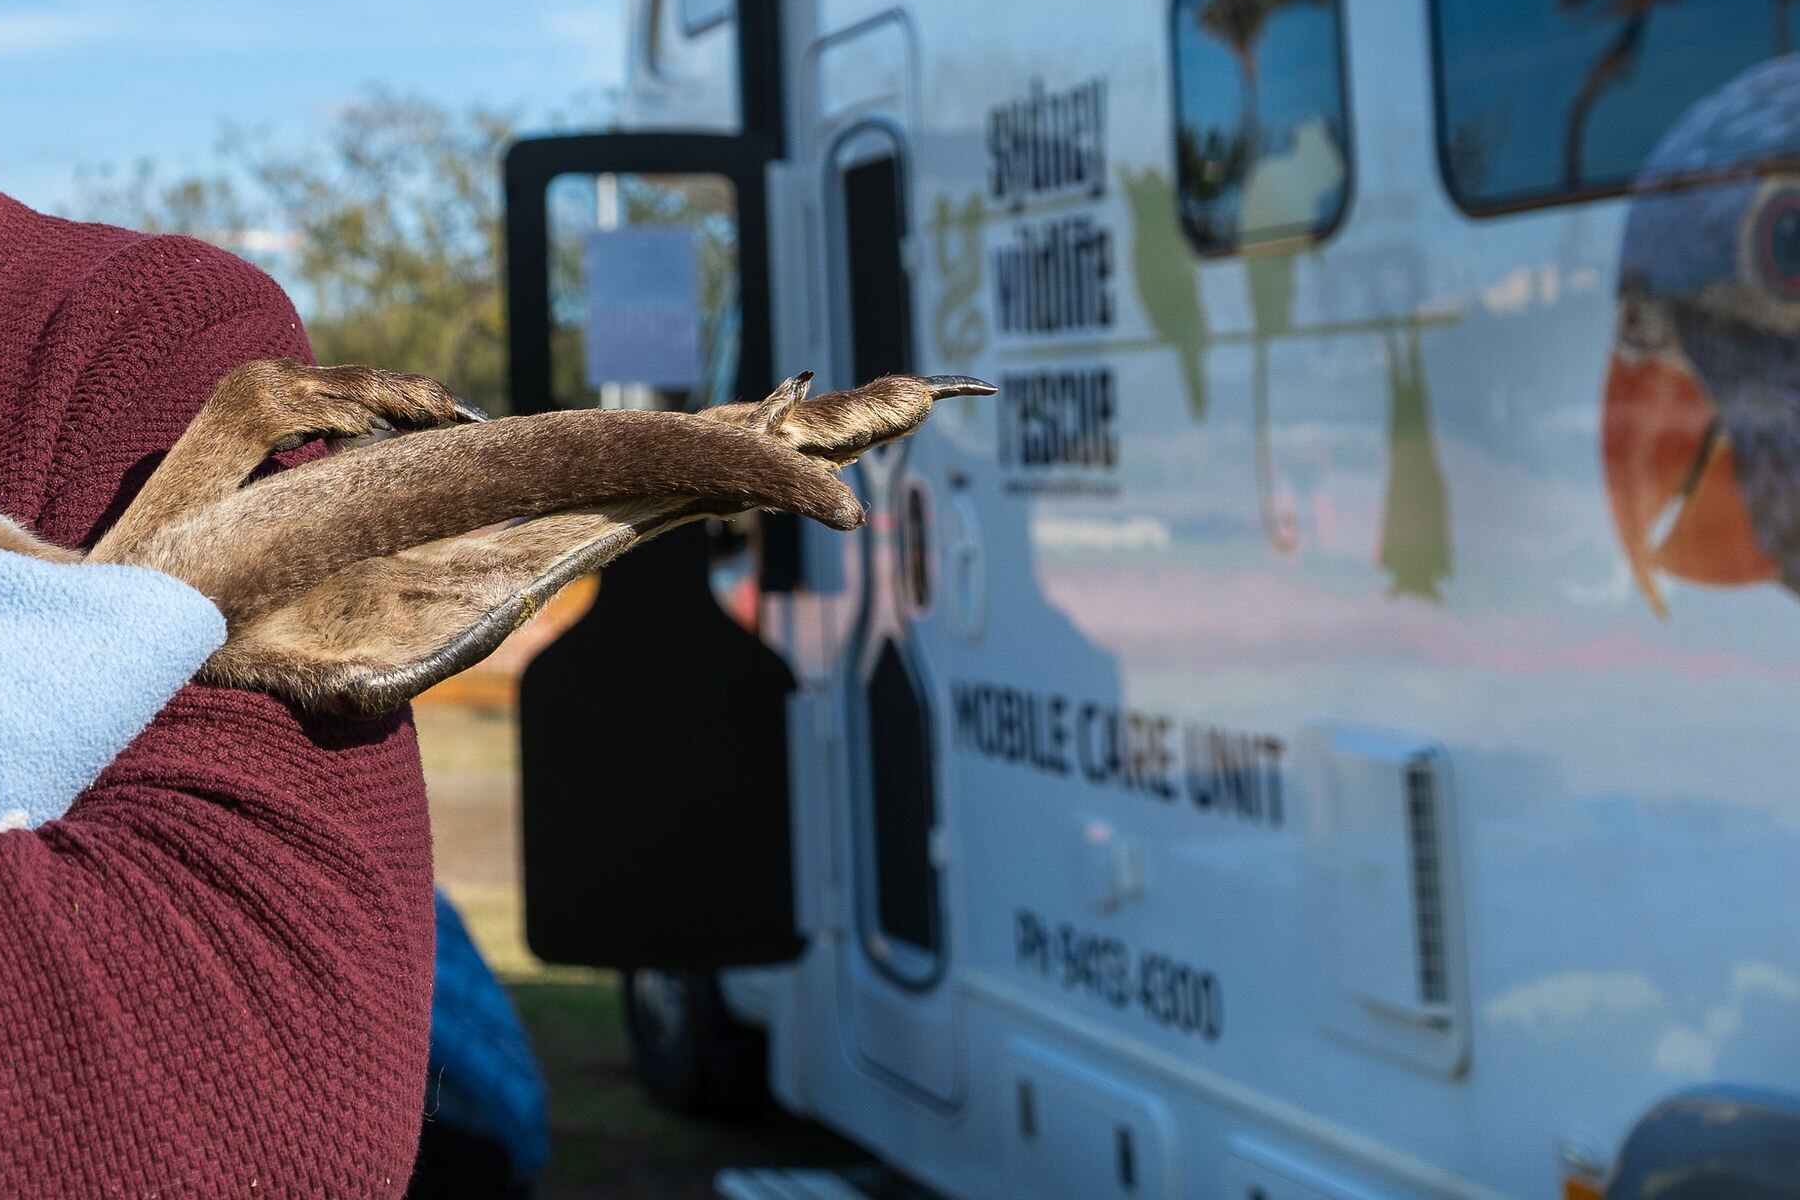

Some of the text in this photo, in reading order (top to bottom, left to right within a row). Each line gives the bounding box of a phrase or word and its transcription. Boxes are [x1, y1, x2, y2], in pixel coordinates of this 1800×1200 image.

[952, 681, 1286, 827] MOBILE CARE UNIT
